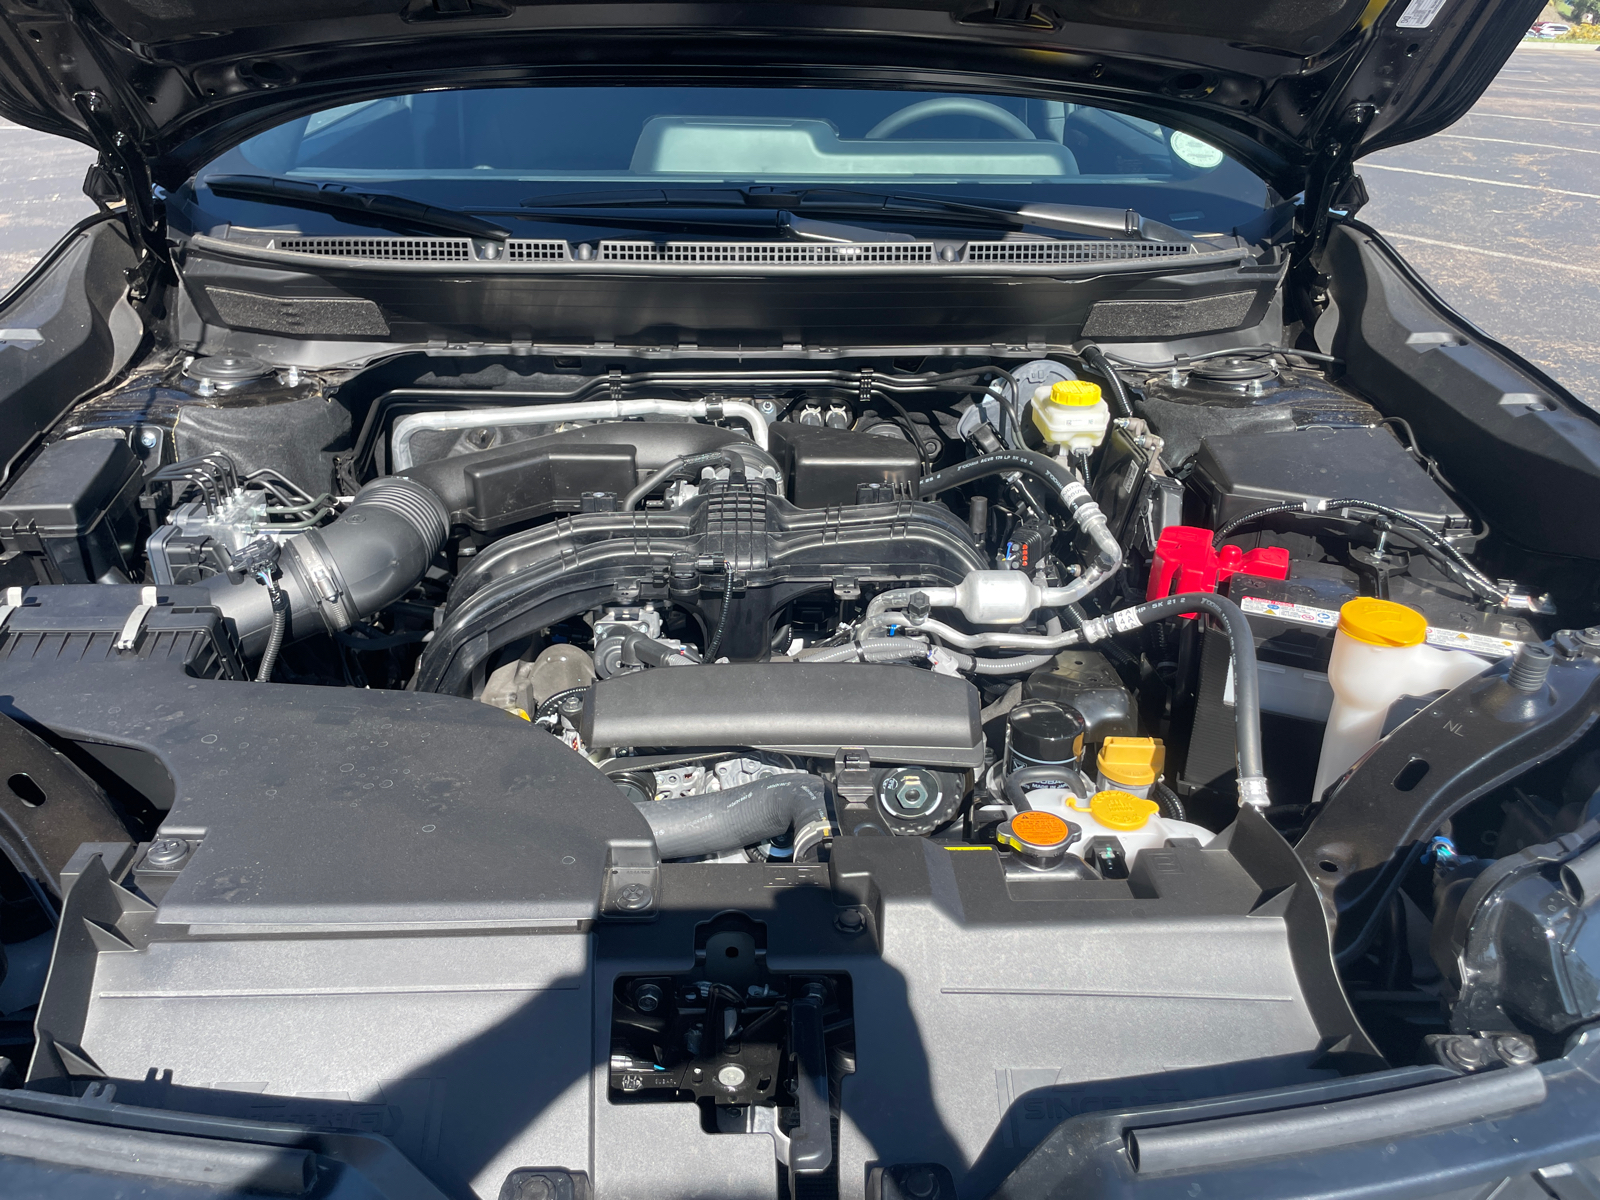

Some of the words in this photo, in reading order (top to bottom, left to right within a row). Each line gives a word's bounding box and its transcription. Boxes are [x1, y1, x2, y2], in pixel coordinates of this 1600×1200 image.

[1151, 601, 1164, 609] 5K
[1166, 598, 1176, 606] 21
[1443, 720, 1464, 737] NL
